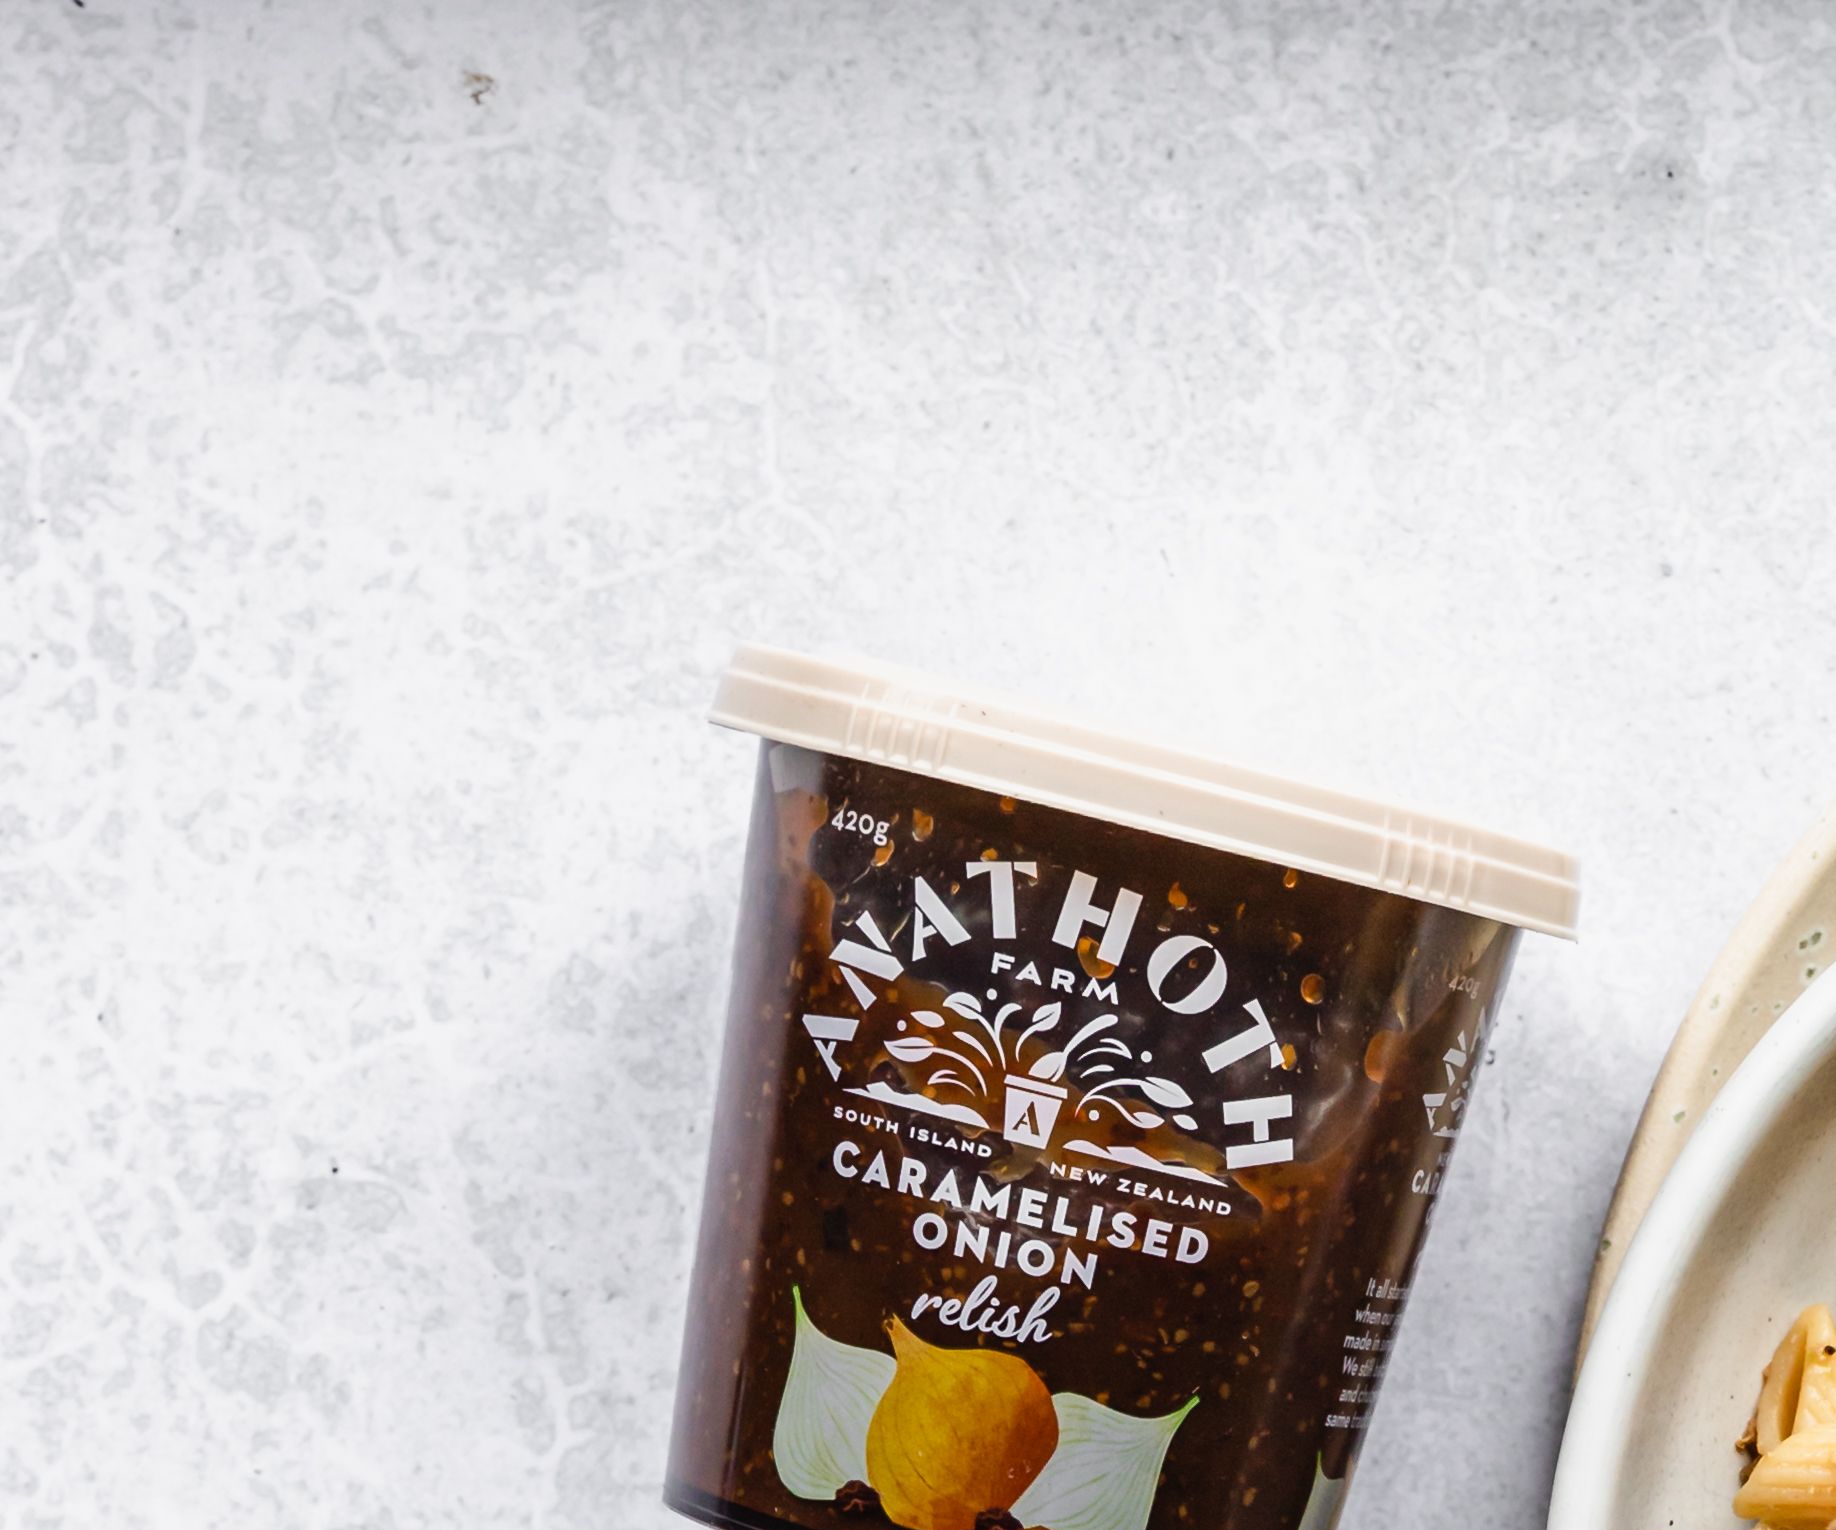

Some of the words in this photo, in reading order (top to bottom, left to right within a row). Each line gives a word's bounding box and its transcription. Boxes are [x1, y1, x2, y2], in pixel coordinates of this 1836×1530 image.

[832, 810, 890, 847] 420g
[991, 952, 1119, 1005] FARM
[1448, 975, 1481, 1000] 420g
[802, 861, 1294, 1170] ANATHOTH
[832, 1106, 899, 1135] SOUTH
[909, 1127, 993, 1158] ISLAND
[832, 1141, 1210, 1265] CARAMELISED
[1049, 1161, 1107, 1187] NEW
[1116, 1178, 1232, 1216] ZEALAND
[912, 1213, 1099, 1291] ONION
[910, 1275, 1061, 1344] relish
[1354, 1304, 1382, 1324] when
[1343, 1330, 1372, 1351] made
[1342, 1355, 1359, 1377] We
[1339, 1382, 1360, 1402] and
[1324, 1412, 1350, 1429] same
